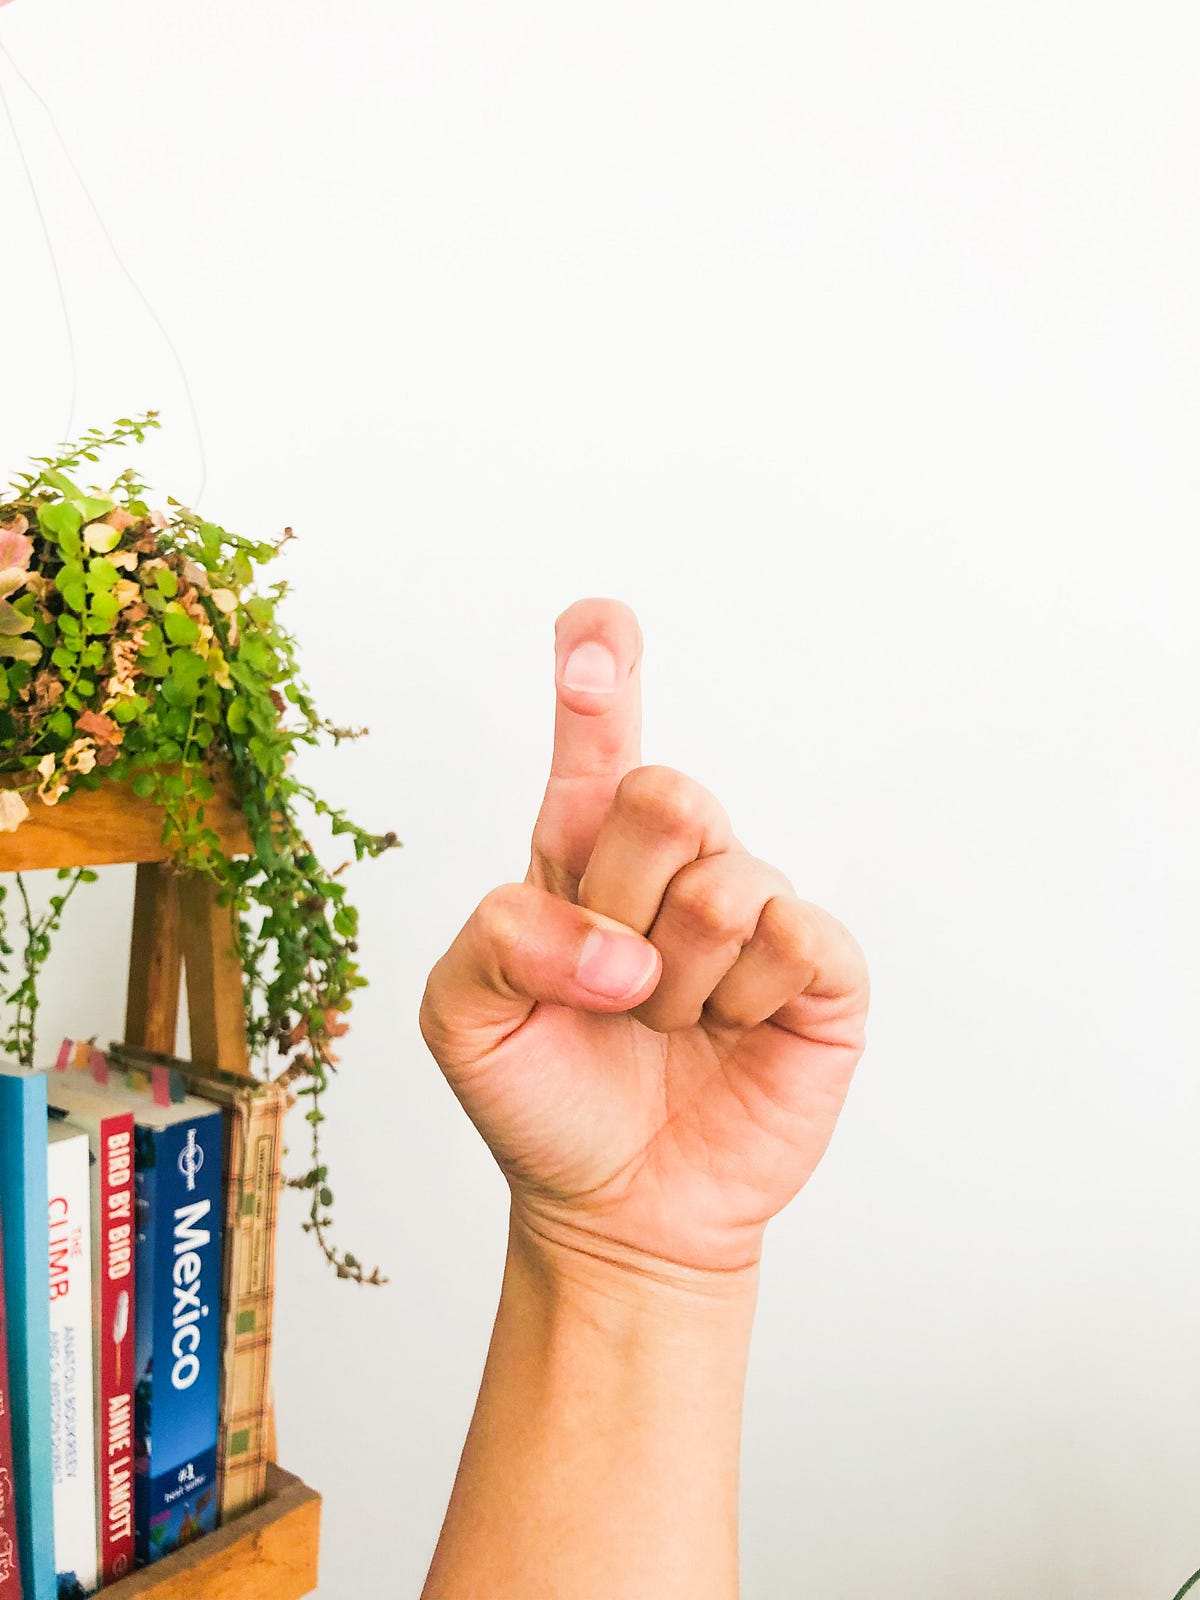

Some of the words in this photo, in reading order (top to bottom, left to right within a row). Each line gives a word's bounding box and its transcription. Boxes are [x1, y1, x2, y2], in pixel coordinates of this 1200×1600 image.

[107, 1131, 130, 1188] BIRD
[108, 1190, 131, 1219] BY
[48, 1198, 69, 1301] CLIMB
[108, 1223, 131, 1280] BIRD
[171, 1199, 211, 1390] Mexico
[108, 1393, 130, 1456] ANNE
[108, 1456, 131, 1543] LAMOTT
